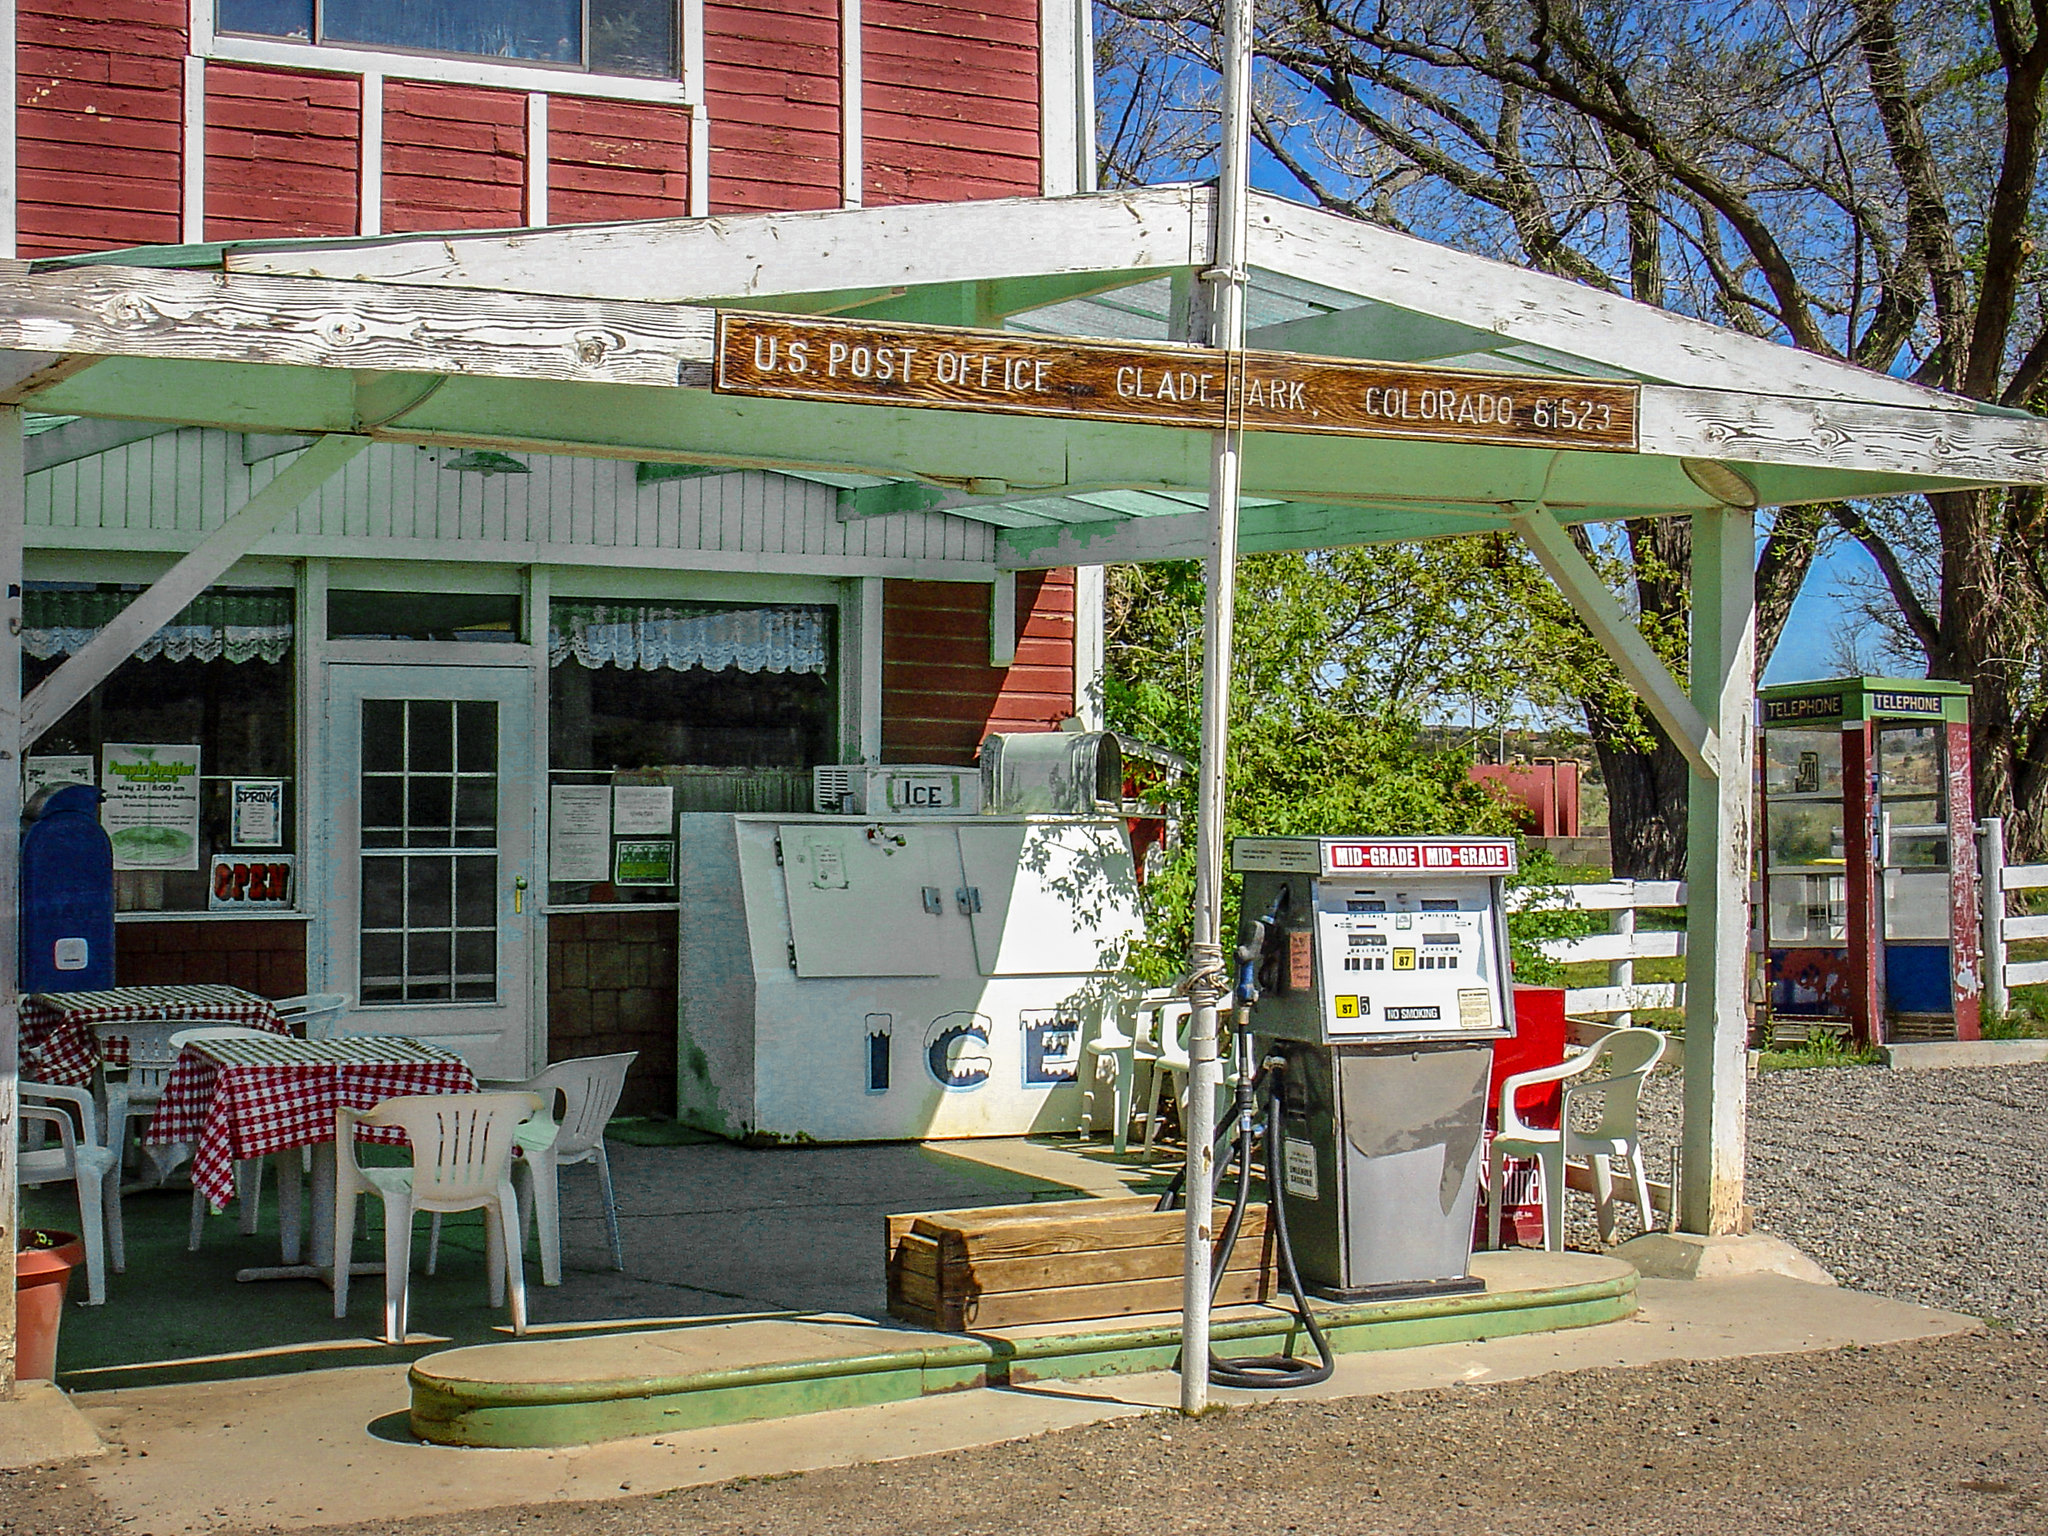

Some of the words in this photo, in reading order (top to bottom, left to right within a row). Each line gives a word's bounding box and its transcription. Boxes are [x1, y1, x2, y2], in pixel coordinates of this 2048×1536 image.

[754, 335, 817, 375] U.S.
[828, 341, 917, 383] POST
[936, 351, 1052, 392] OFFICE
[1116, 365, 1216, 403] GLADE
[1768, 697, 1841, 717] TELEPHONE
[1876, 694, 1940, 711] TELEPHONE
[236, 791, 279, 802] SPRING
[1335, 847, 1417, 867] MID-GRADE
[1426, 847, 1505, 866] MID-GRADE
[214, 863, 290, 901] OPEN
[1398, 956, 1410, 967] 87
[1342, 1004, 1353, 1014] 87
[1361, 997, 1369, 1014] 5
[1387, 1009, 1399, 1019] NO
[1400, 1008, 1438, 1019] SMOKING
[864, 1008, 1081, 1095] ICE
